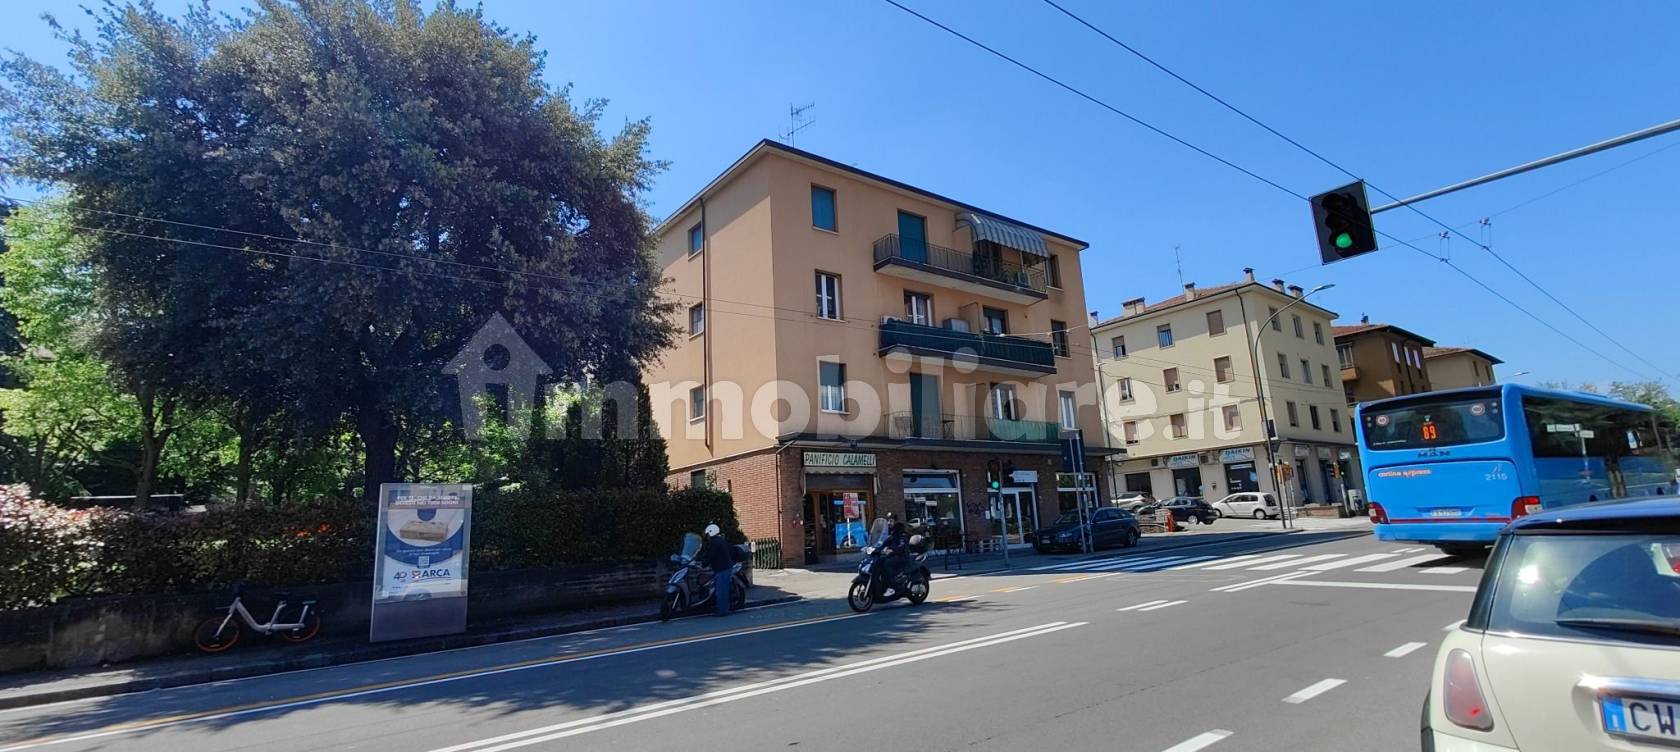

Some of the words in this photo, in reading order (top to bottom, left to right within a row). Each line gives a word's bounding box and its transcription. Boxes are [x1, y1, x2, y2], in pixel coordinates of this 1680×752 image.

[1422, 425, 1437, 440] 89
[1224, 447, 1251, 456] DAIKIN
[804, 453, 839, 465] PANIFICIO
[842, 454, 875, 466] CALAMELLI
[1173, 454, 1196, 462] DAIKIN
[421, 568, 450, 577] ARCA
[1629, 702, 1676, 736] CW
